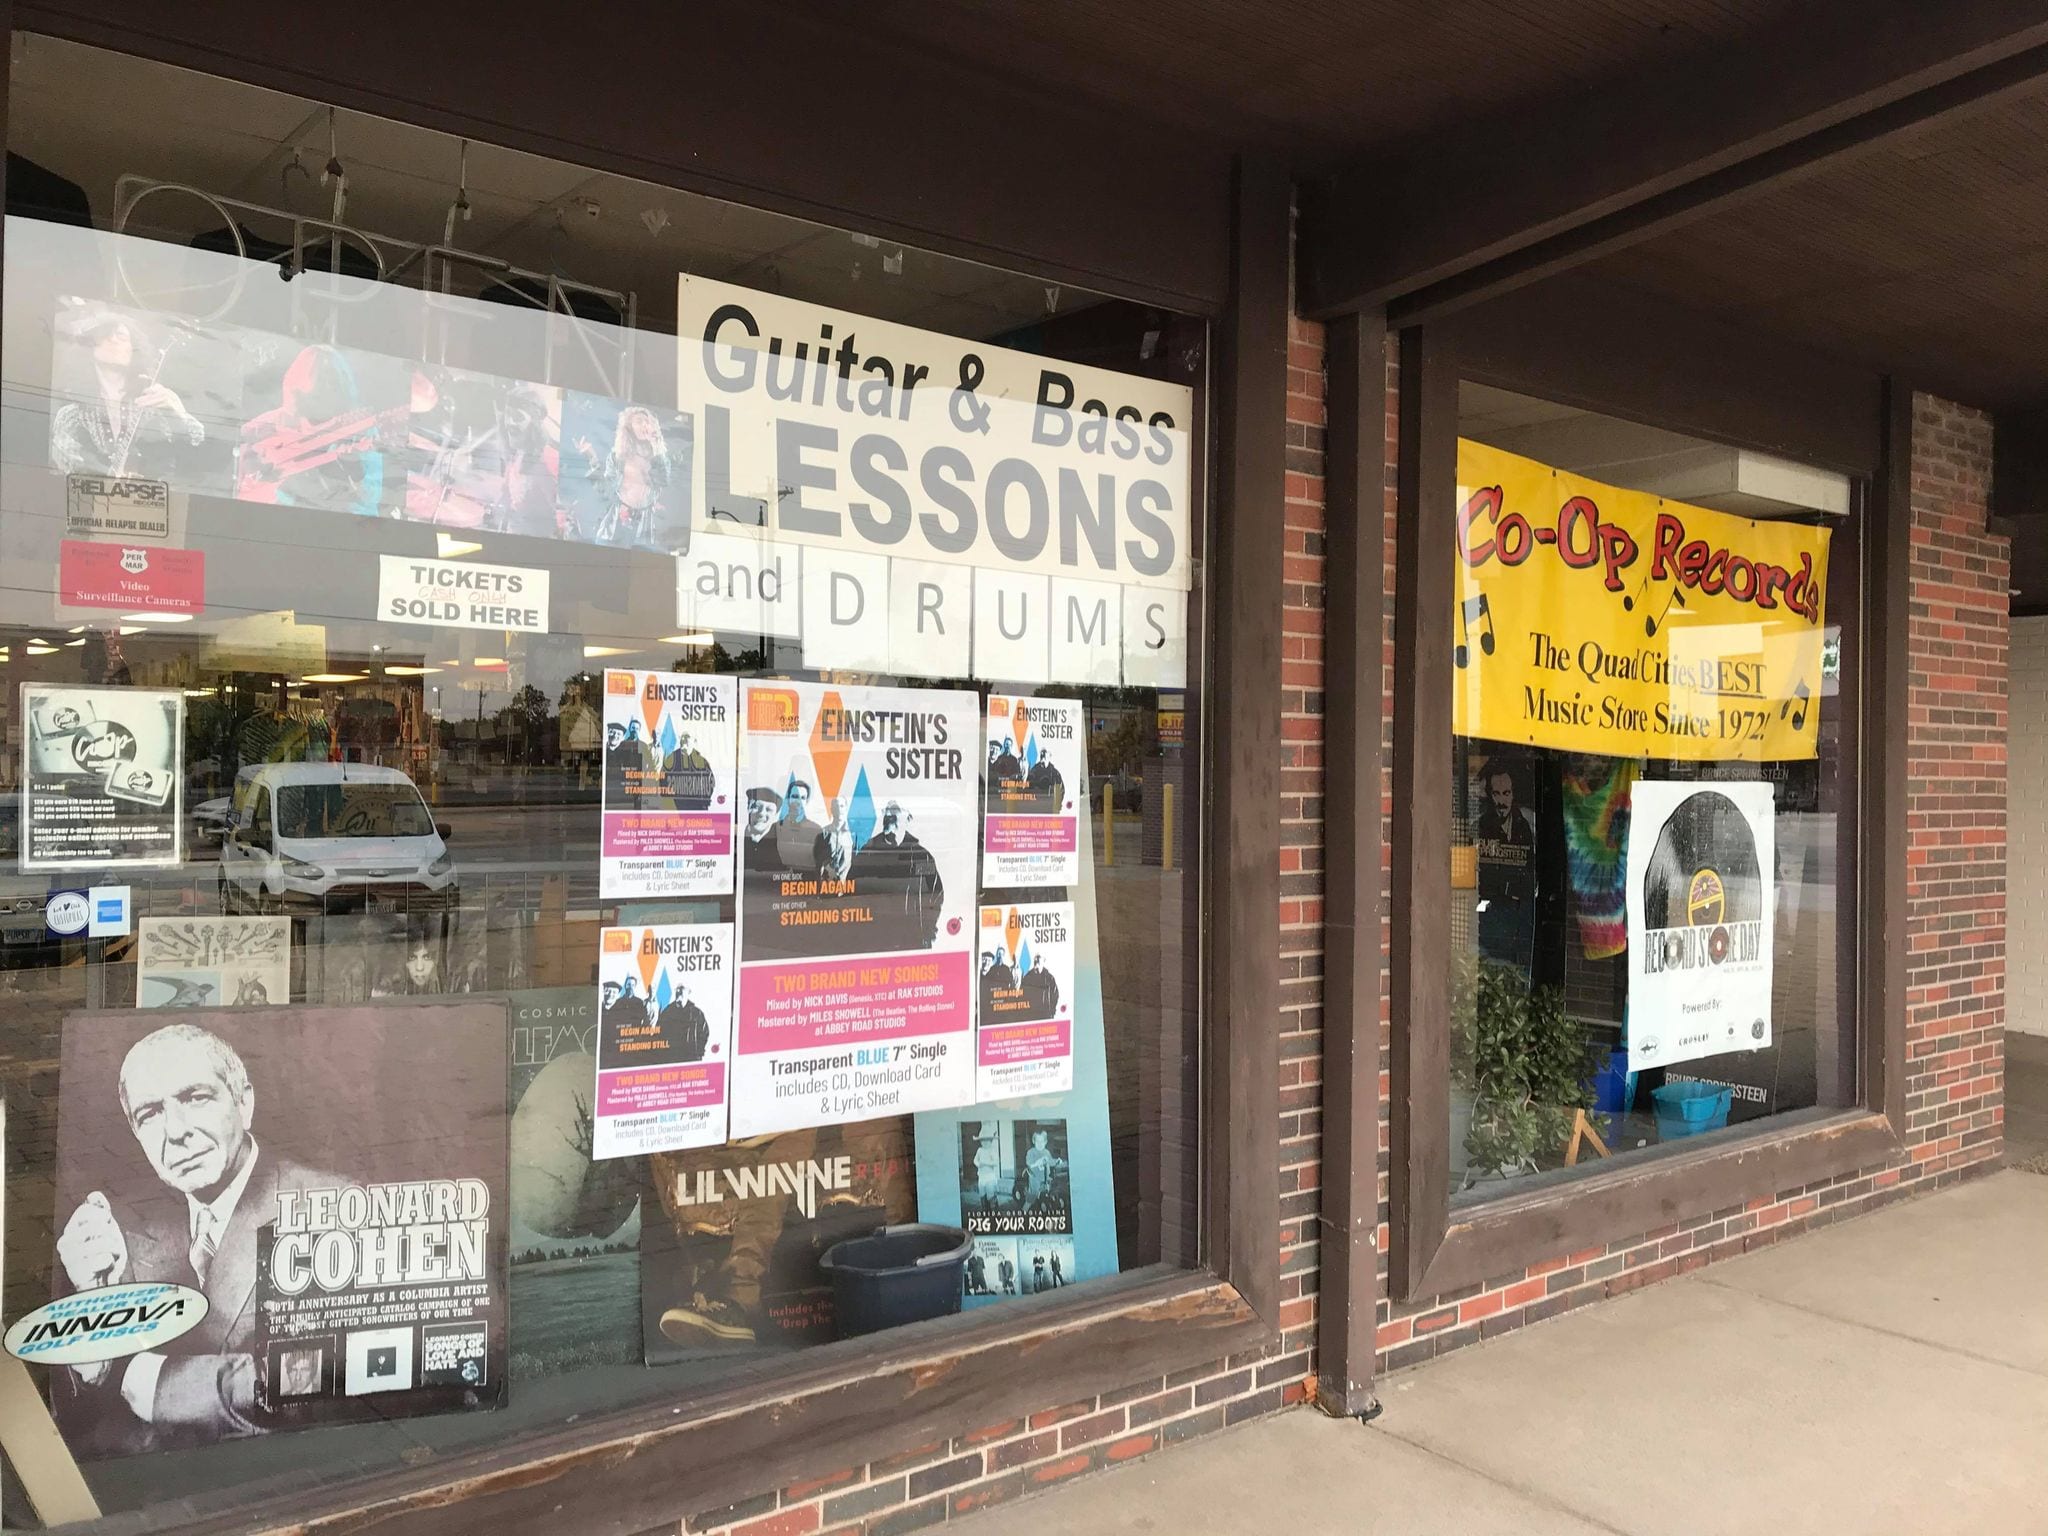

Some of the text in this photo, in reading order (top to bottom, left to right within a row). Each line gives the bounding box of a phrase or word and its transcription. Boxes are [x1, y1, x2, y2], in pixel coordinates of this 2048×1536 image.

[702, 303, 1175, 467] Guitar & Bass
[71, 478, 165, 500] RELAPSE
[705, 404, 1176, 577] LESSONS
[71, 516, 165, 532] OFFICIAL RELAPSE DEALER
[1458, 485, 1819, 625] Co-Op Records
[120, 581, 150, 591] Video
[410, 566, 523, 593] TICKETS
[695, 557, 782, 604] and
[76, 590, 191, 607] Surveillance Cameras
[418, 586, 456, 601] CASH
[390, 598, 538, 627] SOLD HERE
[1530, 631, 1570, 673] The
[1578, 640, 1639, 684] Quad
[1700, 658, 1767, 696] BEST
[647, 684, 717, 703] EINSTEIN'S
[681, 704, 725, 722] SISTER
[1017, 707, 1067, 723] EINSTEIN'S
[1524, 685, 1772, 740] Music Store Since 1972!
[821, 709, 948, 745] EINSTEIN'S
[1041, 724, 1073, 739] SISTER
[886, 748, 962, 779] SISTER
[1702, 767, 1789, 780] BRUCE SPRINGSTEEN
[620, 861, 664, 870] Transparent
[666, 860, 683, 868] BLUE
[695, 859, 716, 869] Single
[781, 880, 855, 896] BEGIN AGAIN
[781, 908, 873, 926] STANDING STILL
[1010, 913, 1060, 929] EINSTEIN'S
[643, 936, 713, 955] EINSTEIN'S
[1035, 928, 1066, 943] SISTER
[1645, 923, 1761, 974] RECORD STORE DAY
[677, 954, 721, 972] SISTER
[774, 964, 939, 993] TWO BRAND NEW SONGS!
[766, 998, 790, 1012] Mixed
[792, 997, 802, 1010] by
[804, 995, 823, 1008] NICK
[826, 993, 848, 1006] DAVIS
[888, 990, 896, 1000] at
[897, 987, 912, 999] RAK
[914, 985, 943, 998] STUDIOS
[1683, 999, 1711, 1014] Powered
[520, 1007, 587, 1018] COSMIC
[758, 1015, 796, 1028] Mastered
[797, 1013, 807, 1025] by
[810, 1010, 833, 1024] MILES
[835, 1007, 871, 1021] SHOWELL
[908, 1005, 917, 1014] The
[815, 1016, 906, 1036] at ABBEY ROAD STUDIOS
[770, 1052, 853, 1076] Transparent
[857, 1047, 890, 1066] BLUE
[910, 1041, 947, 1061] Single
[775, 1062, 941, 1098] includes CD, Download Card
[1700, 1078, 1767, 1103] GSTEEN
[820, 1089, 900, 1115] & Lyric Sheet
[677, 1170, 724, 1206] LIL
[723, 1156, 851, 1218] WAYNE
[274, 1178, 489, 1236] LEONARD
[968, 1216, 1066, 1232] DIG YOUR ROOTS
[271, 1218, 488, 1295] COHEN
[42, 1285, 174, 1312] AUTHORIZED
[50, 1295, 161, 1319] DEALER OF
[300, 1293, 369, 1310] ANNIVERSARY
[373, 1292, 385, 1302] AS
[389, 1291, 396, 1301] A
[400, 1287, 450, 1300] COLUMBIA
[454, 1285, 488, 1295] ARTIST
[23, 1299, 186, 1343] INNOVA
[270, 1315, 286, 1325] THE
[324, 1307, 377, 1320] ANTICIPATED
[380, 1303, 415, 1314] CATALOG
[418, 1300, 458, 1311] CAMPAIGN
[461, 1299, 471, 1308] OF
[475, 1297, 490, 1307] ONE
[270, 1325, 280, 1334] OF
[329, 1317, 359, 1328] GIFTED
[362, 1312, 418, 1325] SONGWRITERS
[421, 1310, 431, 1320] OF
[434, 1309, 450, 1319] OUR
[453, 1307, 473, 1317] TIME
[769, 1305, 813, 1317] Includes
[18, 1322, 159, 1355] GOLF DISCS
[425, 1340, 484, 1352] SONGS OF
[425, 1348, 484, 1361] LOVE AND
[425, 1359, 457, 1371] HATE
